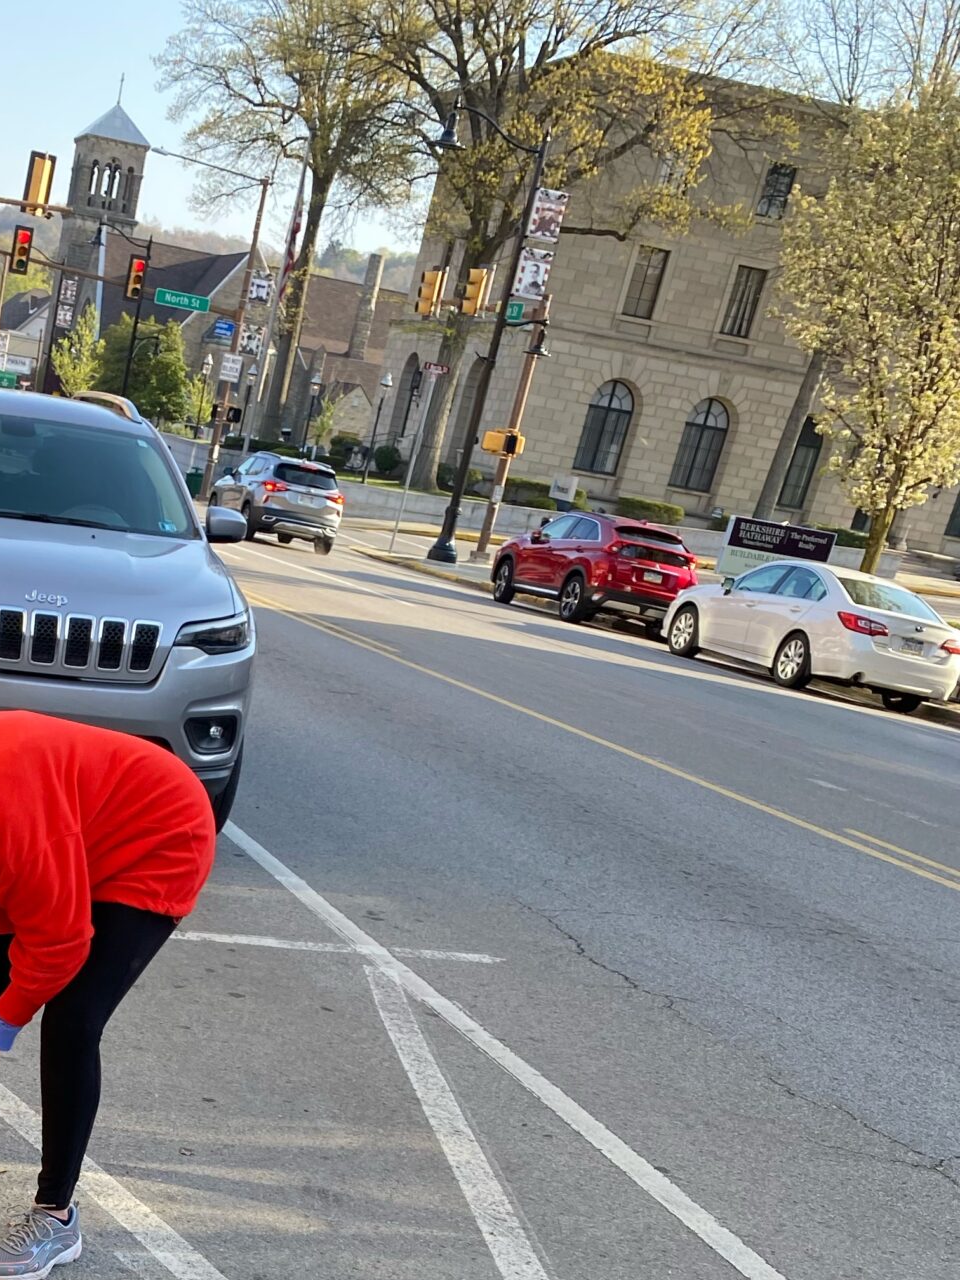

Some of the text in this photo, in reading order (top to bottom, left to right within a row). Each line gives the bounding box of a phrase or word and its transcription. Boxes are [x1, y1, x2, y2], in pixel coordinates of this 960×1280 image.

[165, 293, 200, 308] North St
[739, 531, 782, 545] HATHAWAY
[740, 522, 785, 536] BERKSHIRE
[791, 532, 801, 540] The
[25, 589, 68, 607] Jeep
